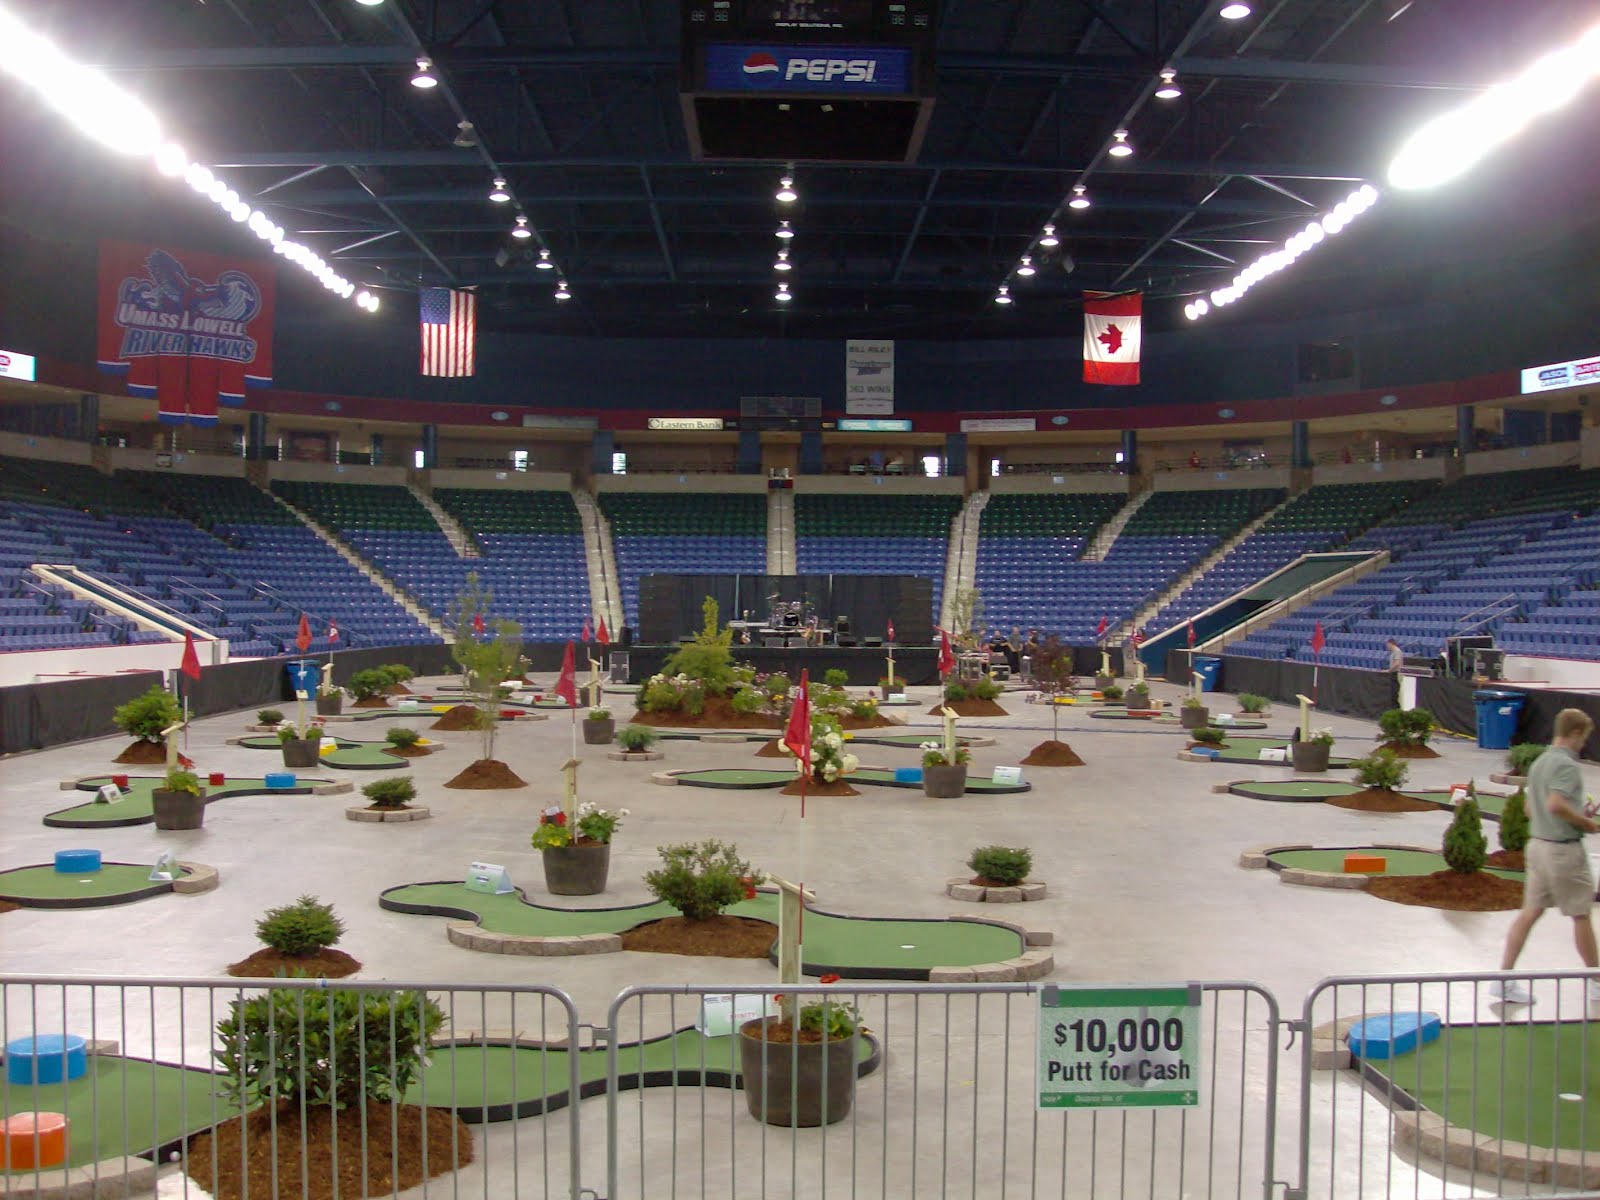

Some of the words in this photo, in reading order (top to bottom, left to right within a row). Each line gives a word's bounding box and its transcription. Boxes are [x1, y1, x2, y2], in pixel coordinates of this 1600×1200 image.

[785, 58, 876, 82] PEPSI
[126, 330, 184, 353] RIVER
[190, 334, 256, 360] HAWKS
[661, 419, 695, 429] Eastern
[697, 419, 721, 429] Bank
[1054, 1018, 1183, 1058] $10,000
[1048, 1061, 1092, 1081] Putt
[1100, 1060, 1130, 1081] for
[1138, 1059, 1190, 1081] Cash
